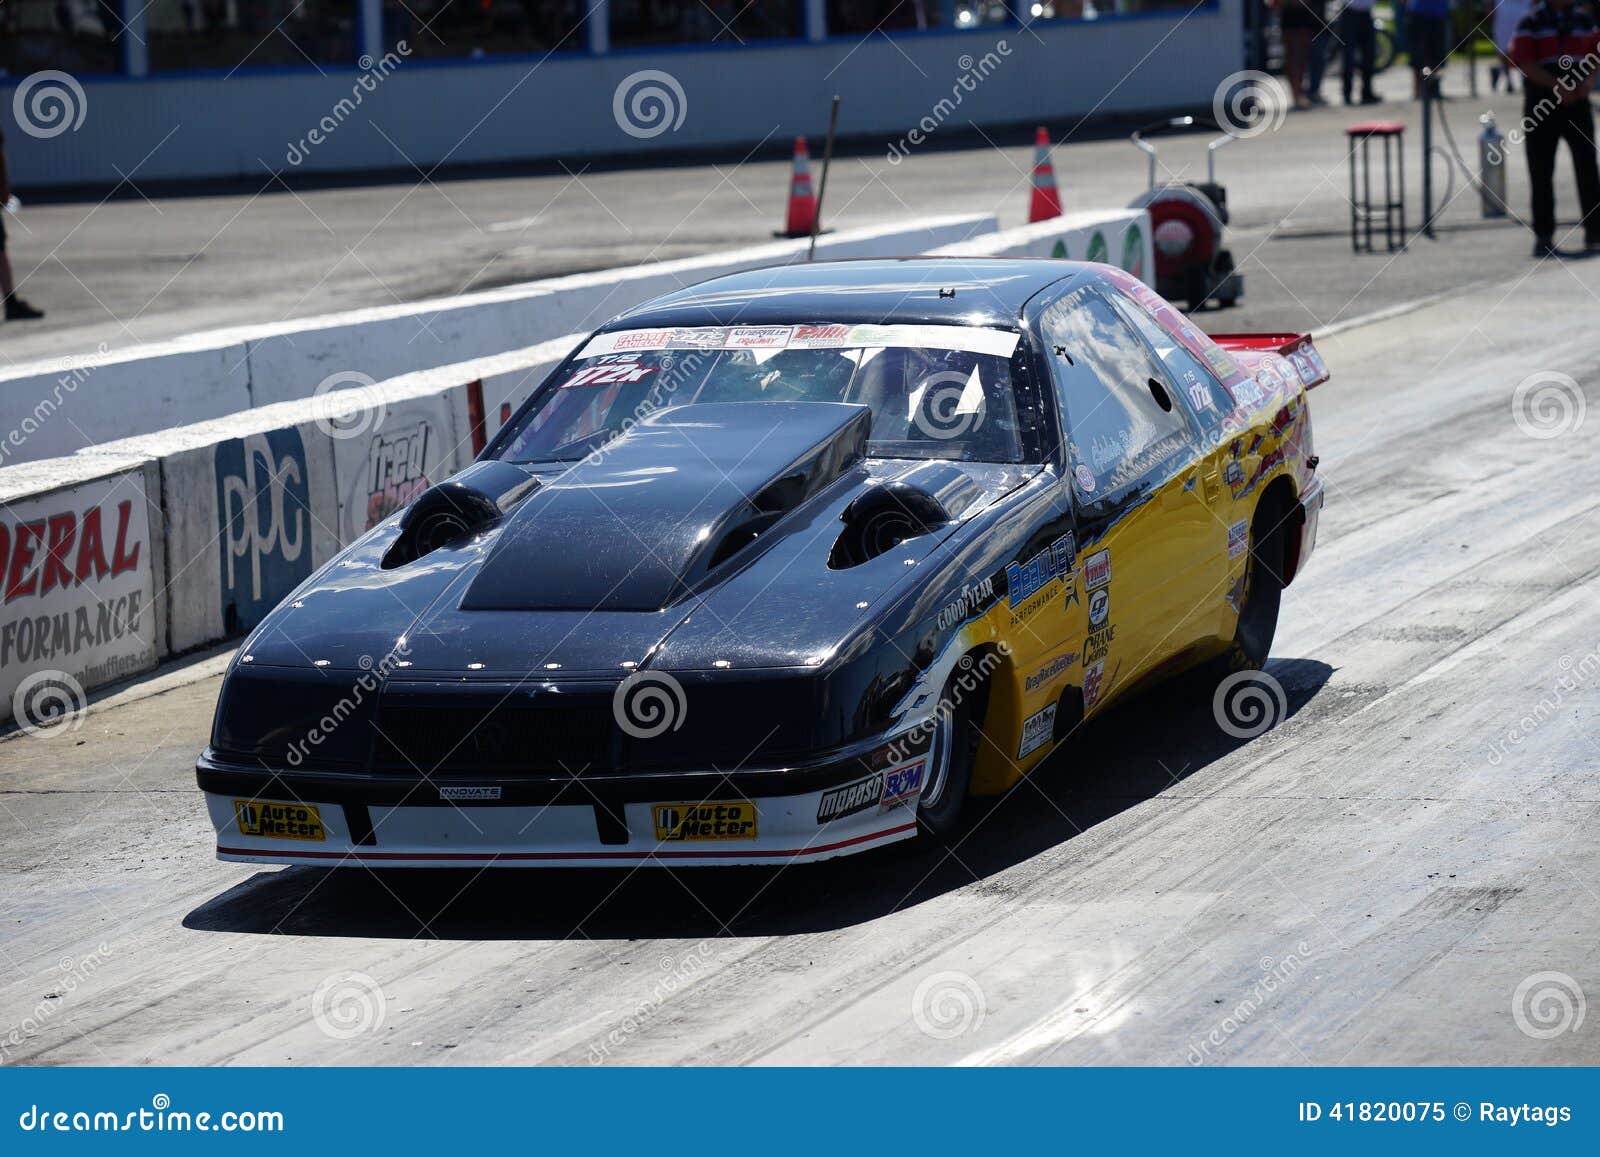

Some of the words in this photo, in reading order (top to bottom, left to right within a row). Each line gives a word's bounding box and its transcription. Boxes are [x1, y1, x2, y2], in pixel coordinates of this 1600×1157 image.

[1009, 585, 1059, 625] PERFORMANCE
[0, 590, 142, 669] FORMANCE
[441, 788, 500, 796] INNOVATE
[819, 777, 883, 817] MOROSO
[261, 804, 308, 821] Auto
[686, 806, 742, 821] Auto
[260, 818, 320, 835] Meter
[680, 820, 753, 838] Meter
